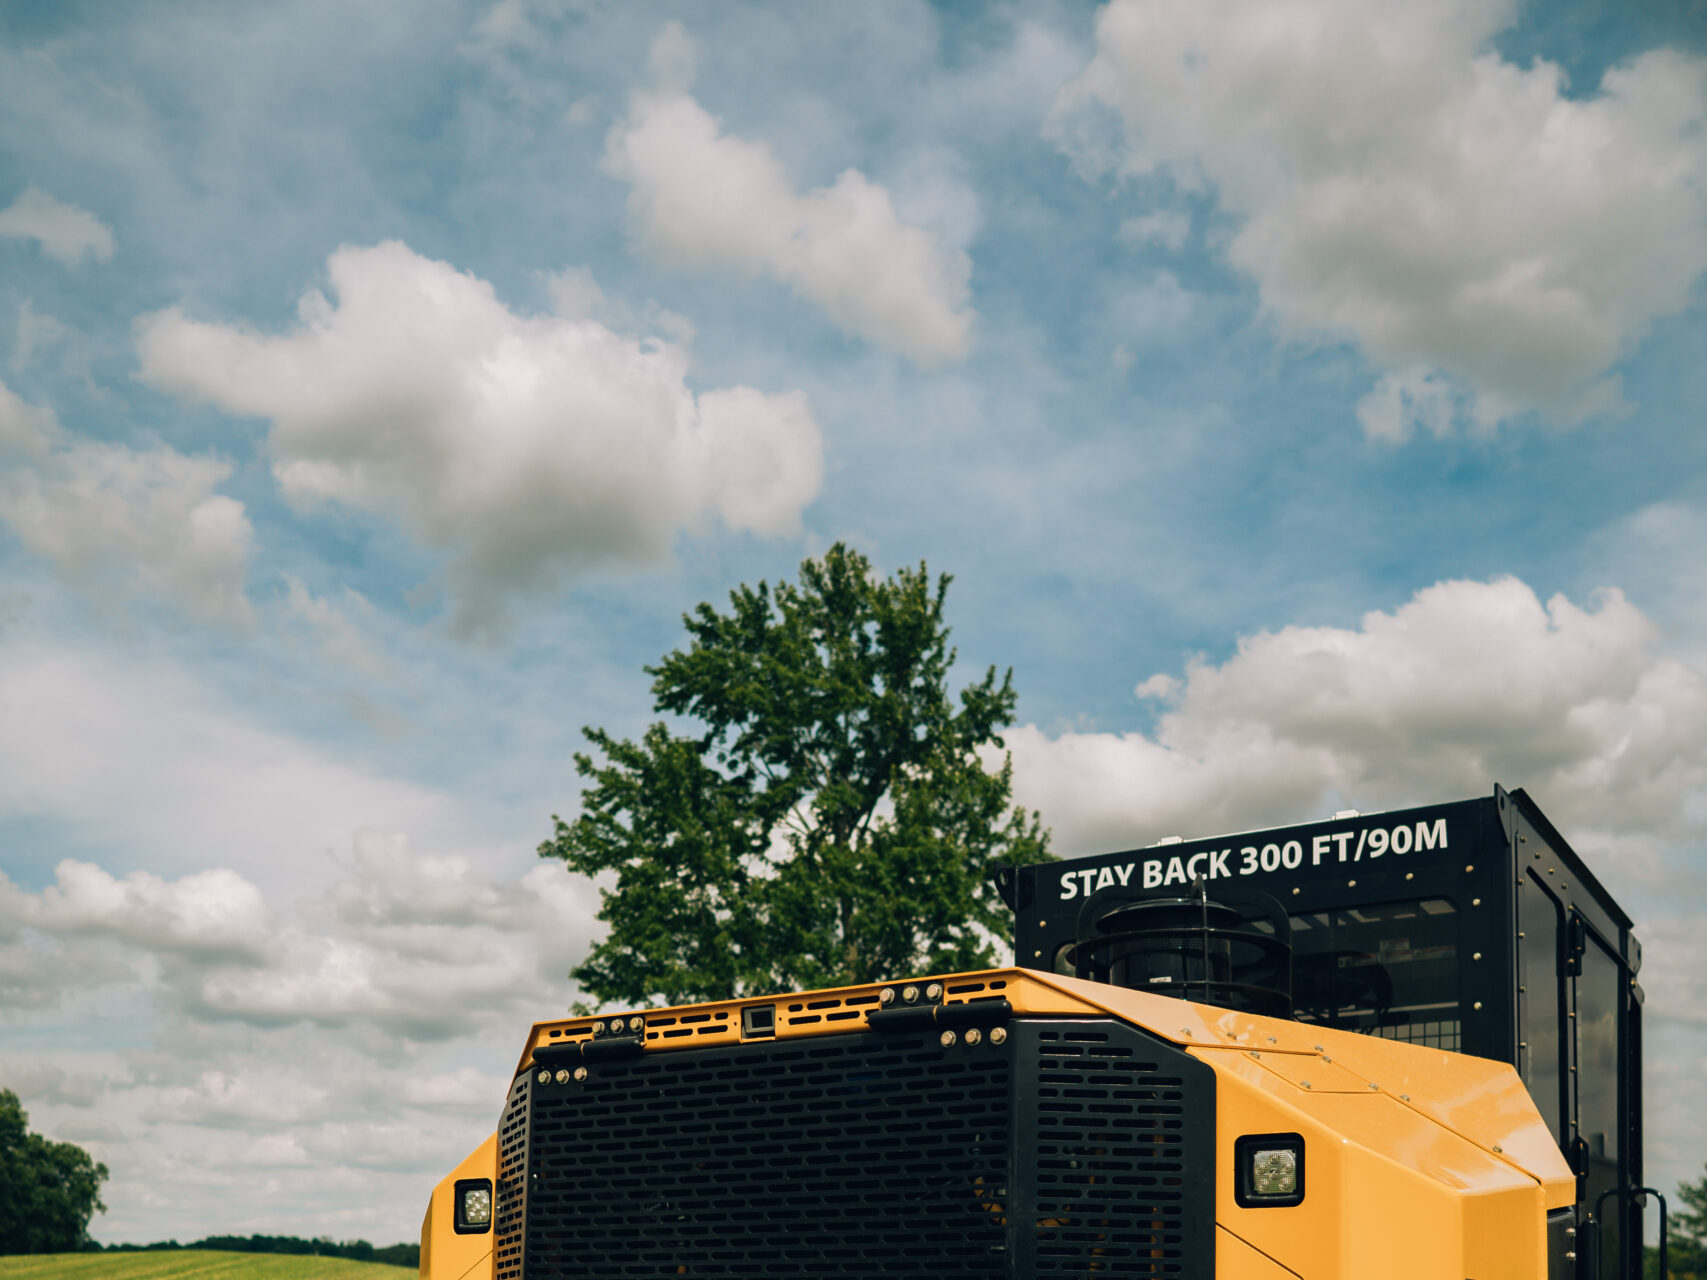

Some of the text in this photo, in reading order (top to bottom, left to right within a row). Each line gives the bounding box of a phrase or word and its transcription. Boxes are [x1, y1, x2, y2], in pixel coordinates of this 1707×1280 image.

[1060, 818, 1448, 900] STAY BACK 300 FT/90M
